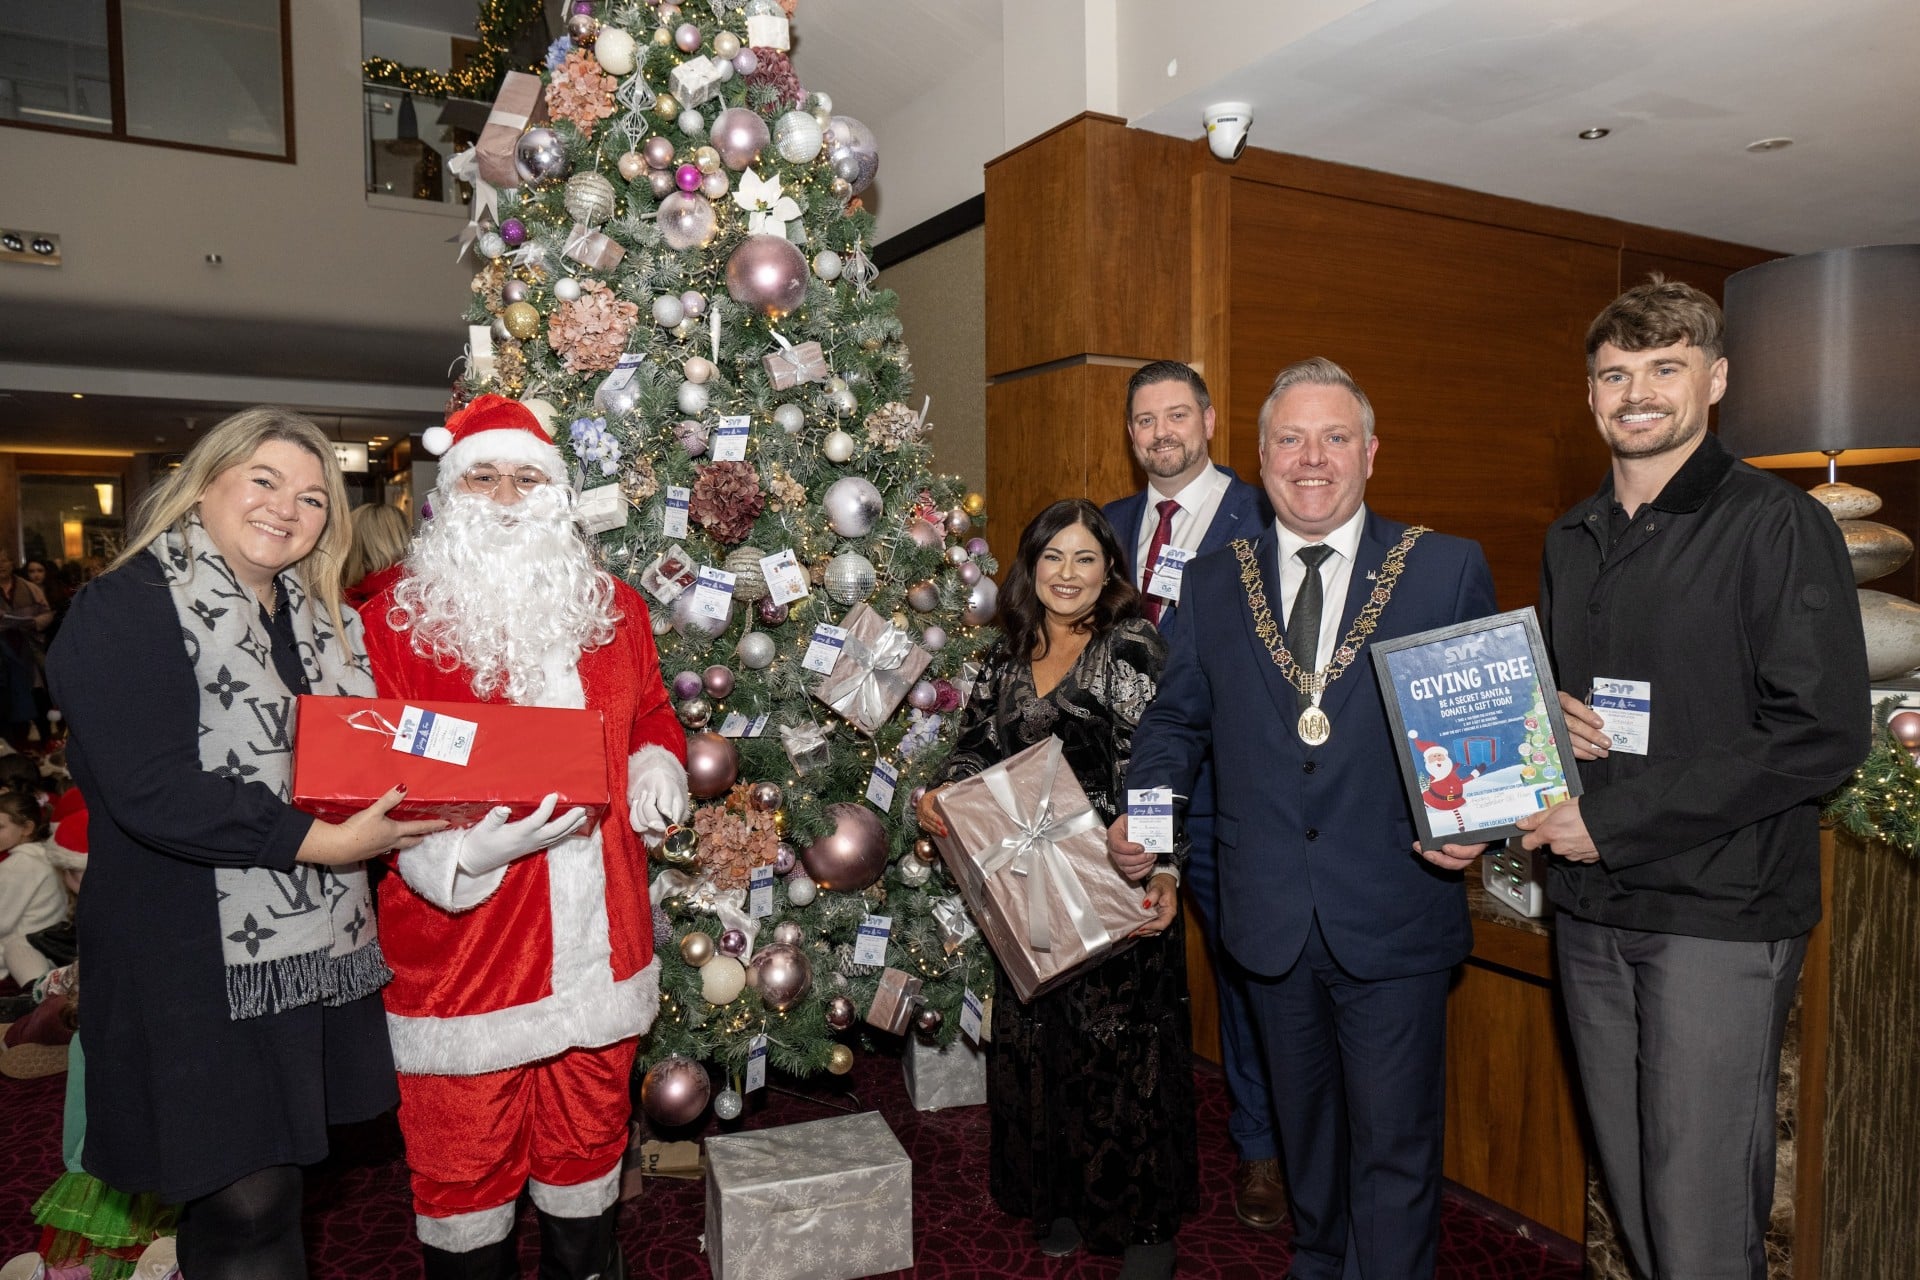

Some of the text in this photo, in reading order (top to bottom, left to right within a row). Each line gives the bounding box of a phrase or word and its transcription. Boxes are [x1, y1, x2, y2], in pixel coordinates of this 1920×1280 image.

[1410, 656, 1532, 701] GIVING TREE
[1609, 683, 1635, 695] SVP
[1439, 698, 1448, 709] BE
[1449, 697, 1455, 707] A
[1454, 692, 1479, 706] SECRET
[1481, 687, 1505, 700] SANTA
[1600, 698, 1616, 707] Giving
[1440, 704, 1467, 719] DONATE
[1468, 704, 1474, 713] A
[1474, 700, 1491, 712] GIFT
[1492, 695, 1513, 709] TODAY
[1139, 792, 1160, 803] SVP
